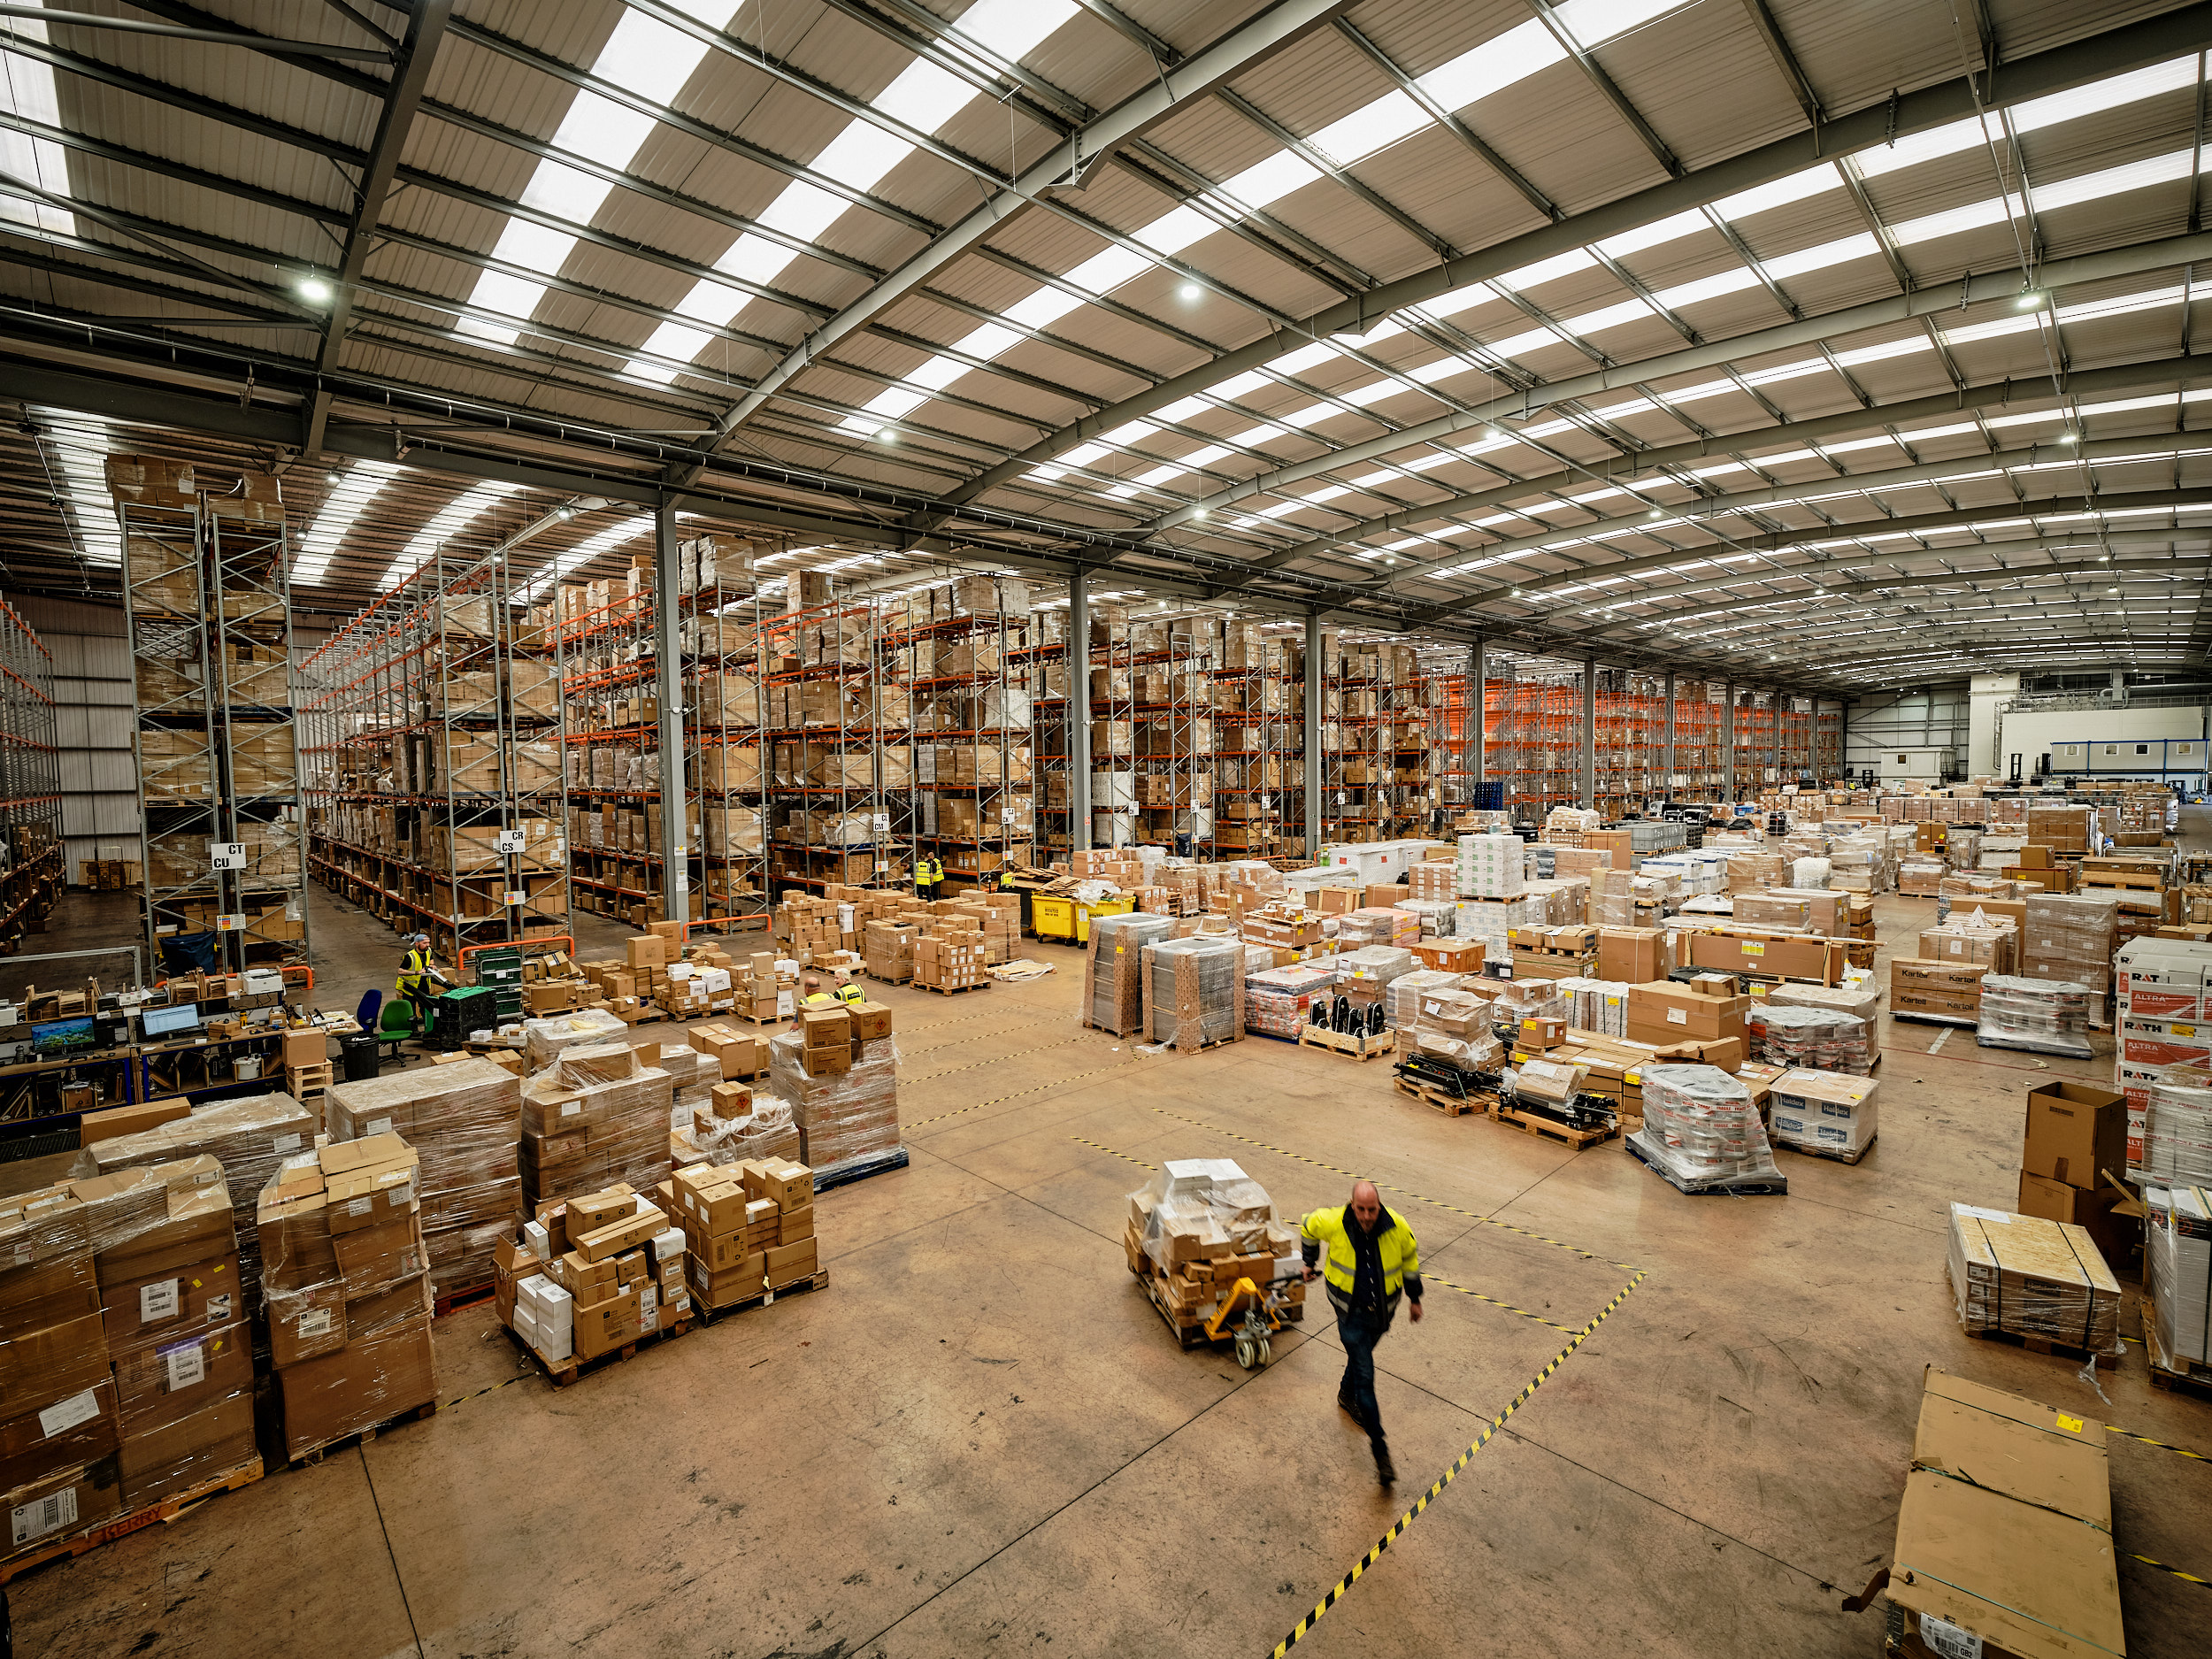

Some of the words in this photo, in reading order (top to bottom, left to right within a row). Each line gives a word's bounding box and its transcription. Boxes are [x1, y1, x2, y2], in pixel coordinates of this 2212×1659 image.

[512, 831, 524, 841] CR
[228, 844, 243, 855] CT
[502, 842, 513, 852] CS
[213, 858, 229, 868] CU
[1901, 995, 1926, 1005] Kartell
[2134, 994, 2166, 1002] ALTRA
[1947, 1001, 1974, 1010] Kartell
[2124, 1021, 2162, 1033] RATH
[2128, 1041, 2159, 1051] ALTRA
[102, 1505, 161, 1539] KERRY
[1960, 1647, 1973, 1658] GB2
